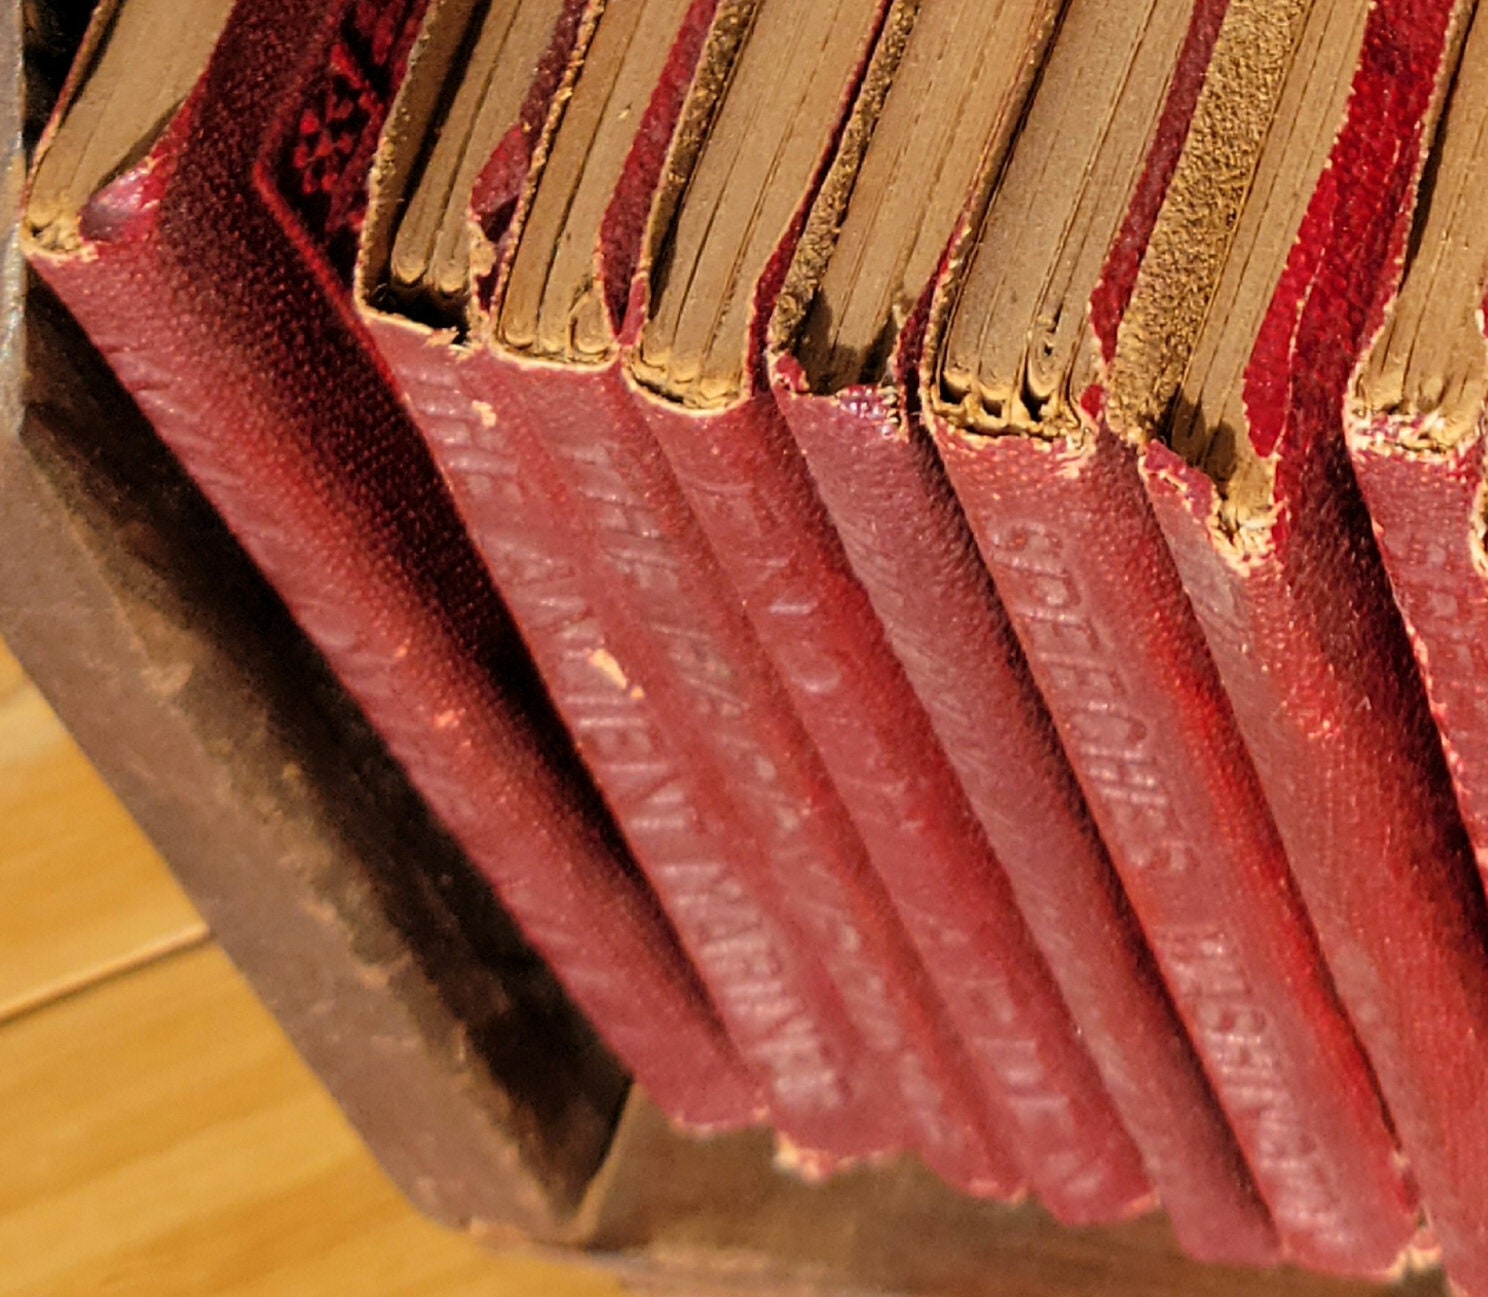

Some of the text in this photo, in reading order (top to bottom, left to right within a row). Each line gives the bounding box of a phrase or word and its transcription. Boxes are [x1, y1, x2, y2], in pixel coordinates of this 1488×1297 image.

[556, 444, 690, 589] THE
[394, 358, 847, 1100] THE ANCIENT MARINER
[979, 518, 1207, 875] SPEECHES
